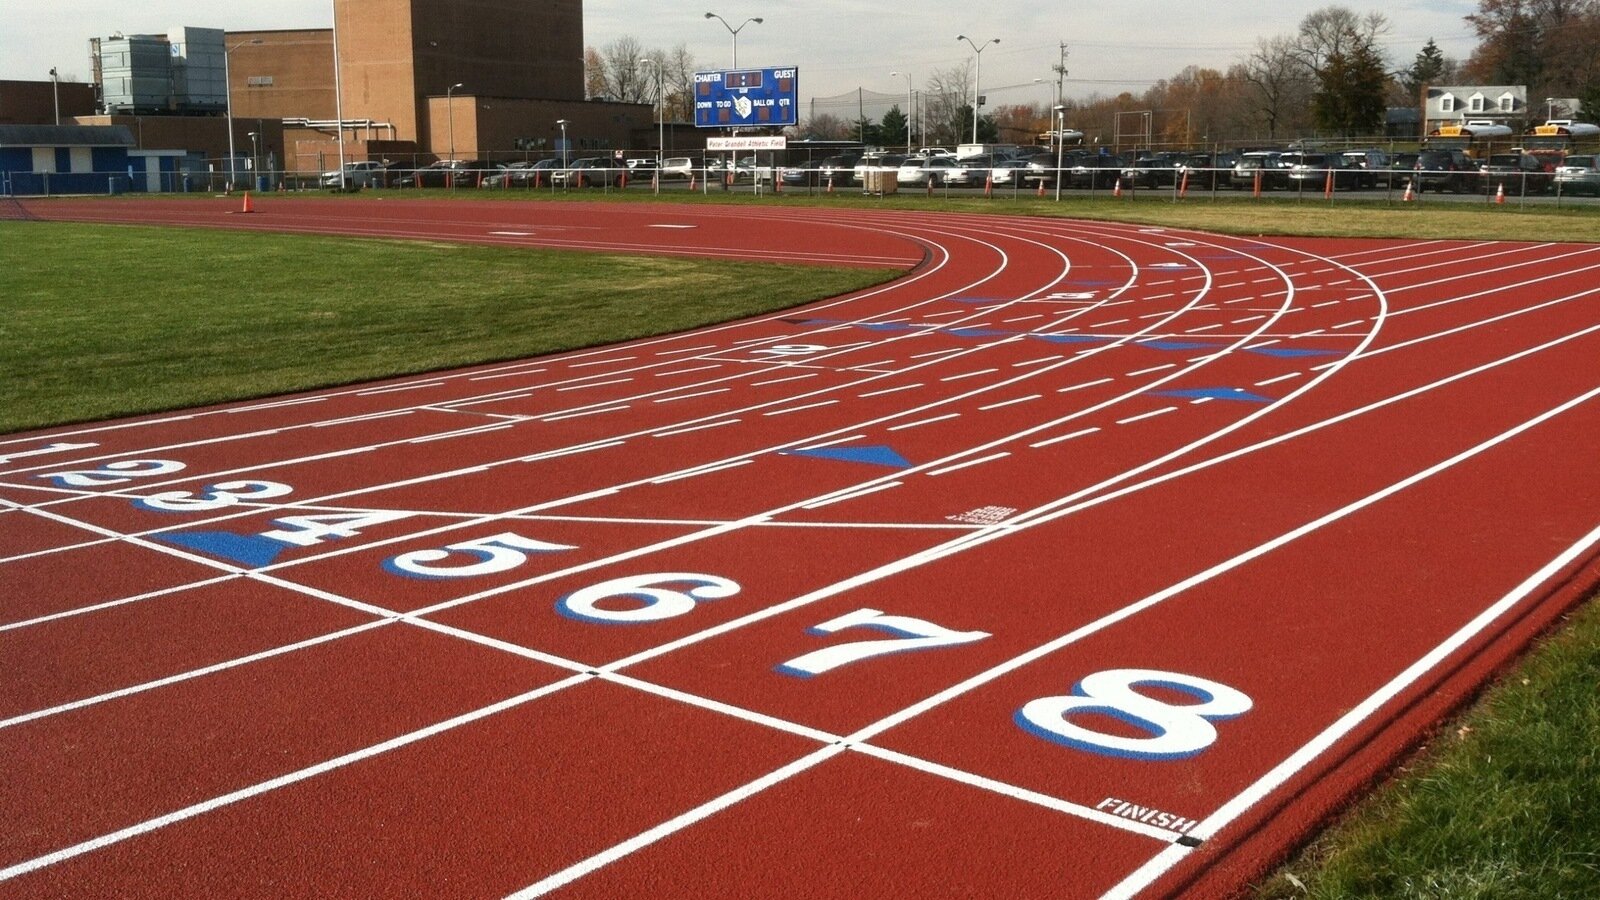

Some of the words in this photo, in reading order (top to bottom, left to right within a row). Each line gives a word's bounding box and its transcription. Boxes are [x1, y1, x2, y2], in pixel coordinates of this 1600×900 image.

[695, 74, 721, 82] CHARTER
[774, 70, 795, 78] GUEST
[0, 442, 100, 464] 1
[33, 459, 187, 487] 2
[131, 480, 293, 513] 3
[259, 511, 415, 546] 4
[380, 532, 580, 580] 5
[555, 573, 741, 623] 6
[776, 608, 992, 677] 7
[1014, 668, 1253, 760] 8
[1096, 797, 1197, 832] FINISH
